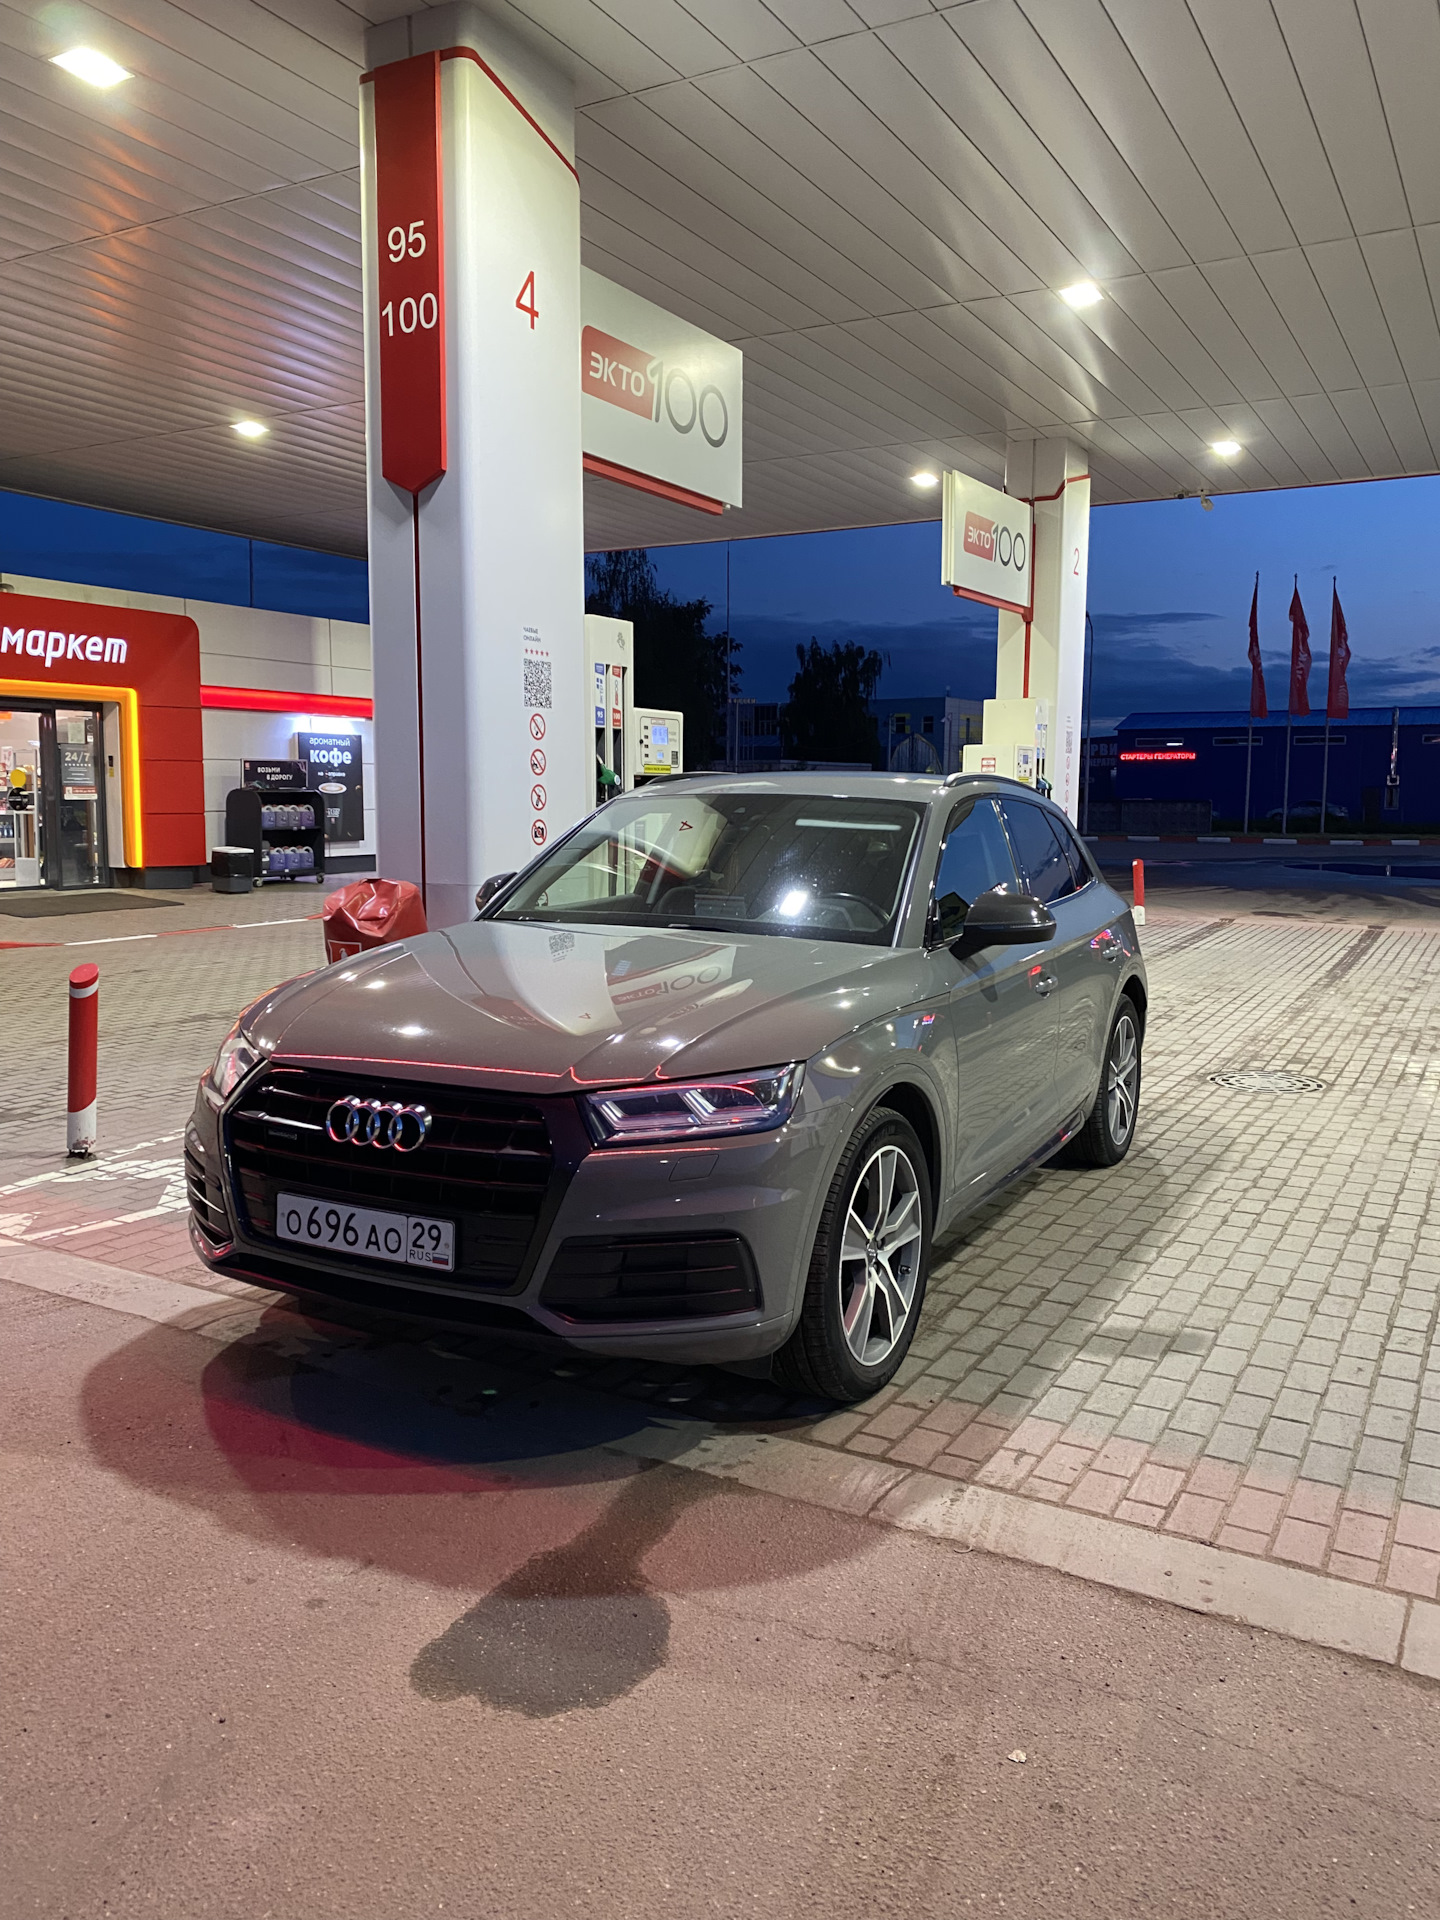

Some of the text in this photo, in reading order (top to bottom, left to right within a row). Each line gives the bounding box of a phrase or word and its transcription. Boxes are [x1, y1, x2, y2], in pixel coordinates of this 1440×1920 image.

[387, 220, 426, 263] 95
[381, 292, 438, 337] 100
[515, 270, 539, 330] 4
[589, 351, 728, 448] ЭКТО 100
[967, 524, 1026, 572] ЭКТО 100
[1073, 547, 1080, 576] 2
[0, 626, 128, 668] маркет
[597, 710, 604, 719] 95
[309, 737, 351, 747] ароматный
[1120, 752, 1153, 761] СТАРТЕРЫ
[64, 751, 90, 763] 24/7
[310, 747, 352, 767] кофе
[411, 1221, 442, 1251] 29
[409, 1249, 432, 1262] RUS
